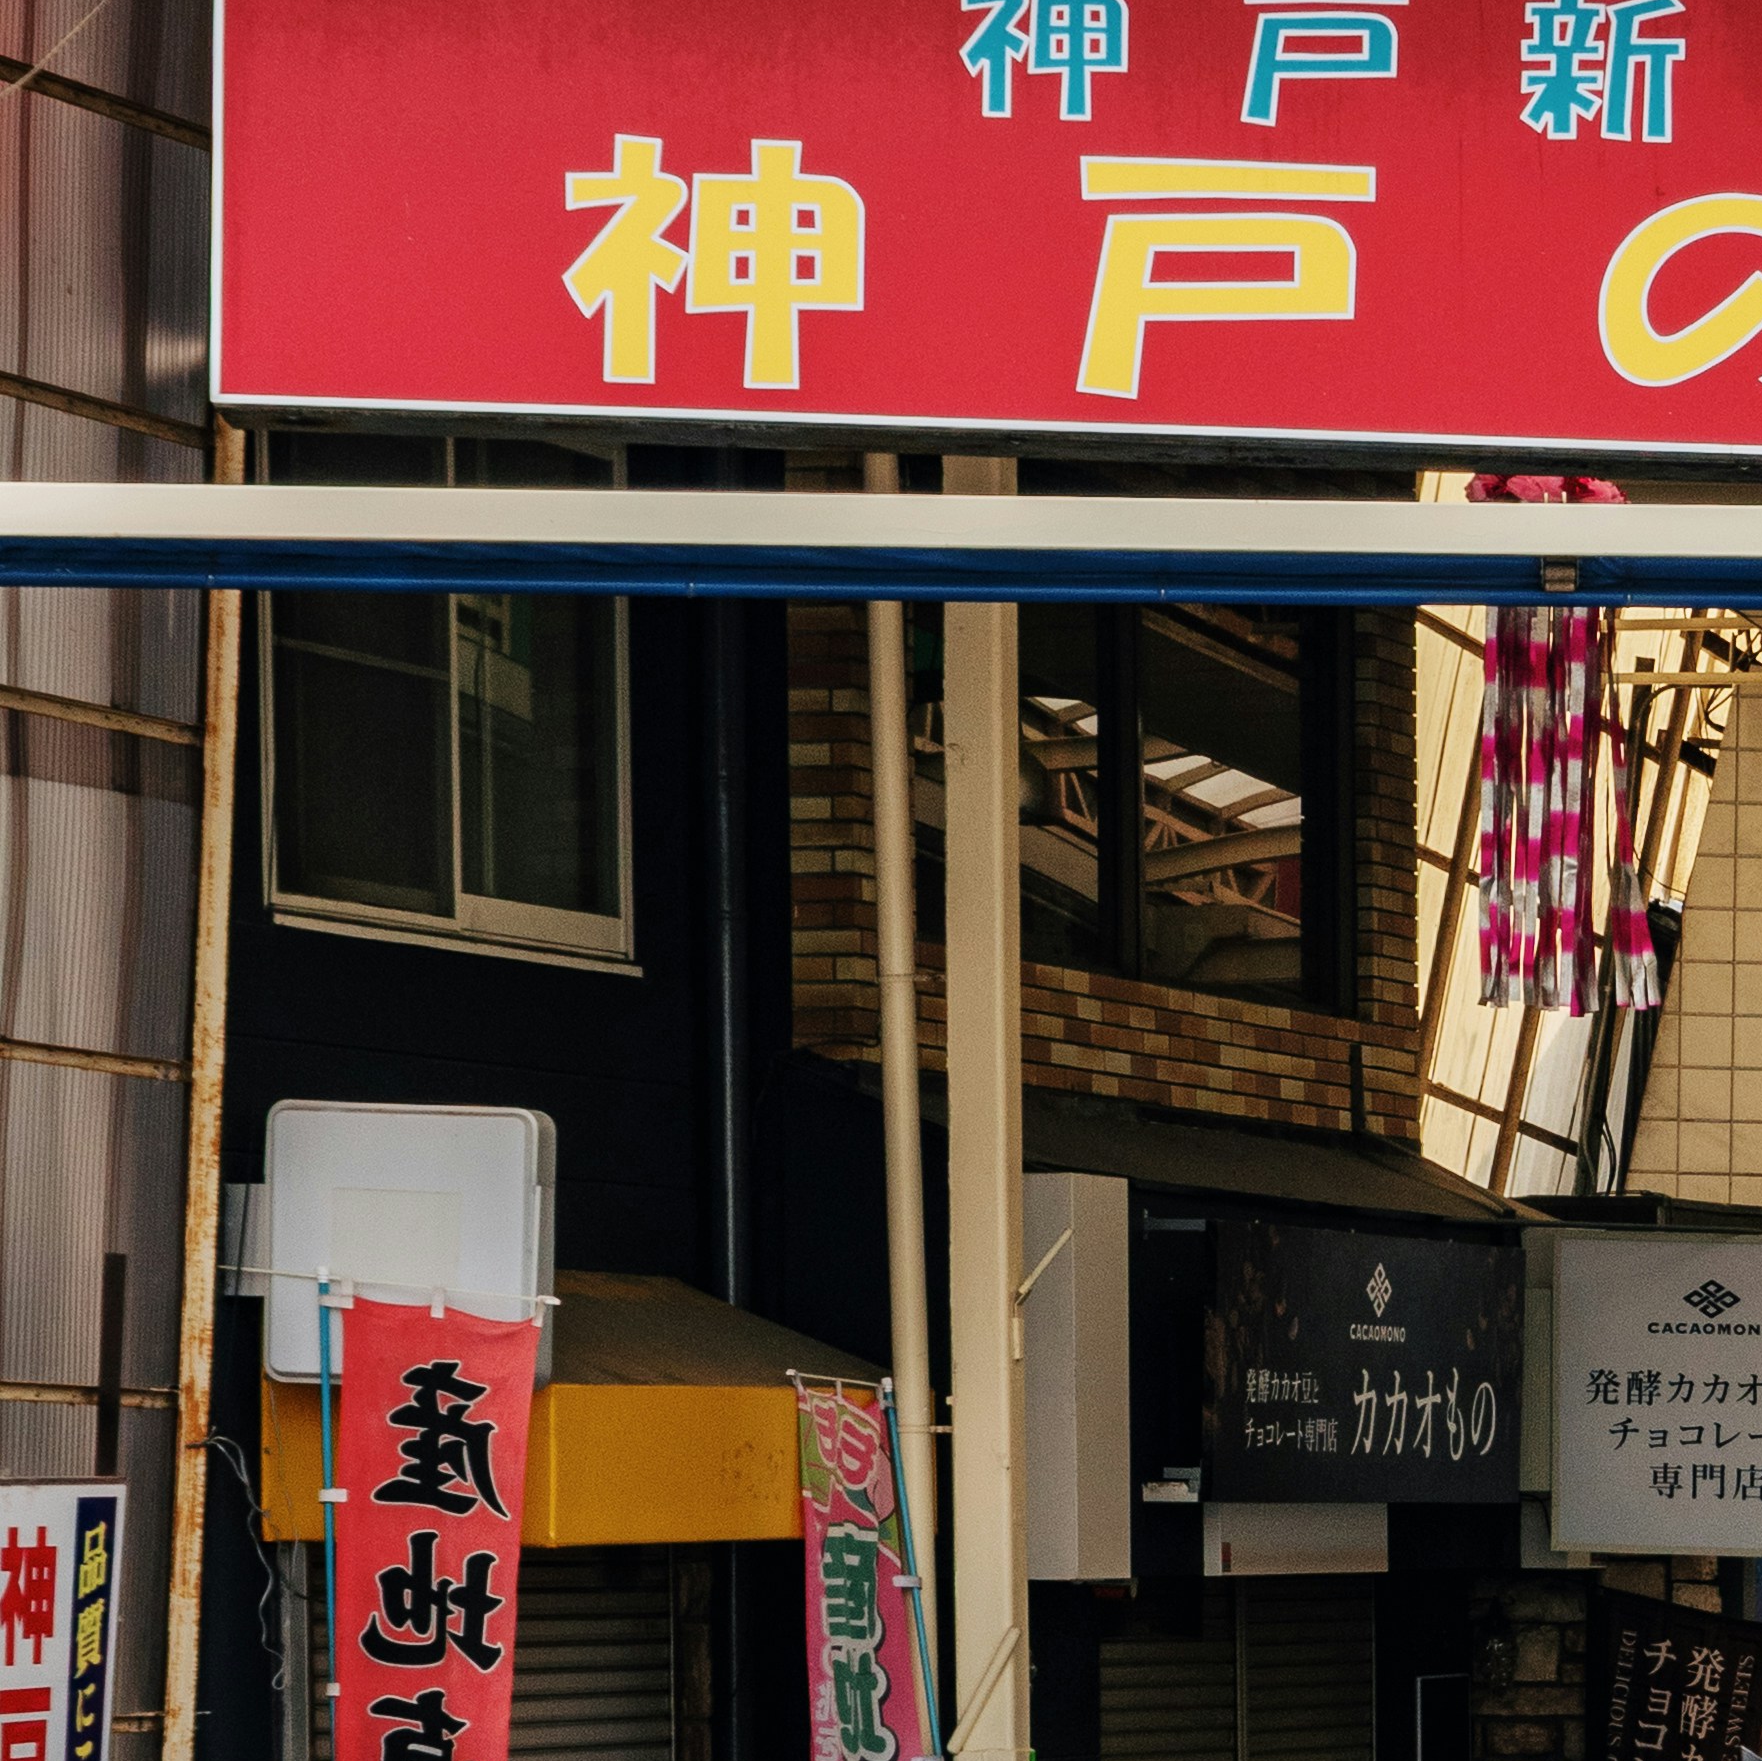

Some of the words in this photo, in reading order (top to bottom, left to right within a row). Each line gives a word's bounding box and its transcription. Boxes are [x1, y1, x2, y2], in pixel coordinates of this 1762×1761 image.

[1351, 1323, 1406, 1342] CACAOMONO
[1246, 1368, 1320, 1404] 発酵カカオ豆と
[1350, 1367, 1496, 1460] カカオもの
[1245, 1417, 1338, 1454] チョコレート専門店
[1724, 1654, 1755, 1748] SWEETS
